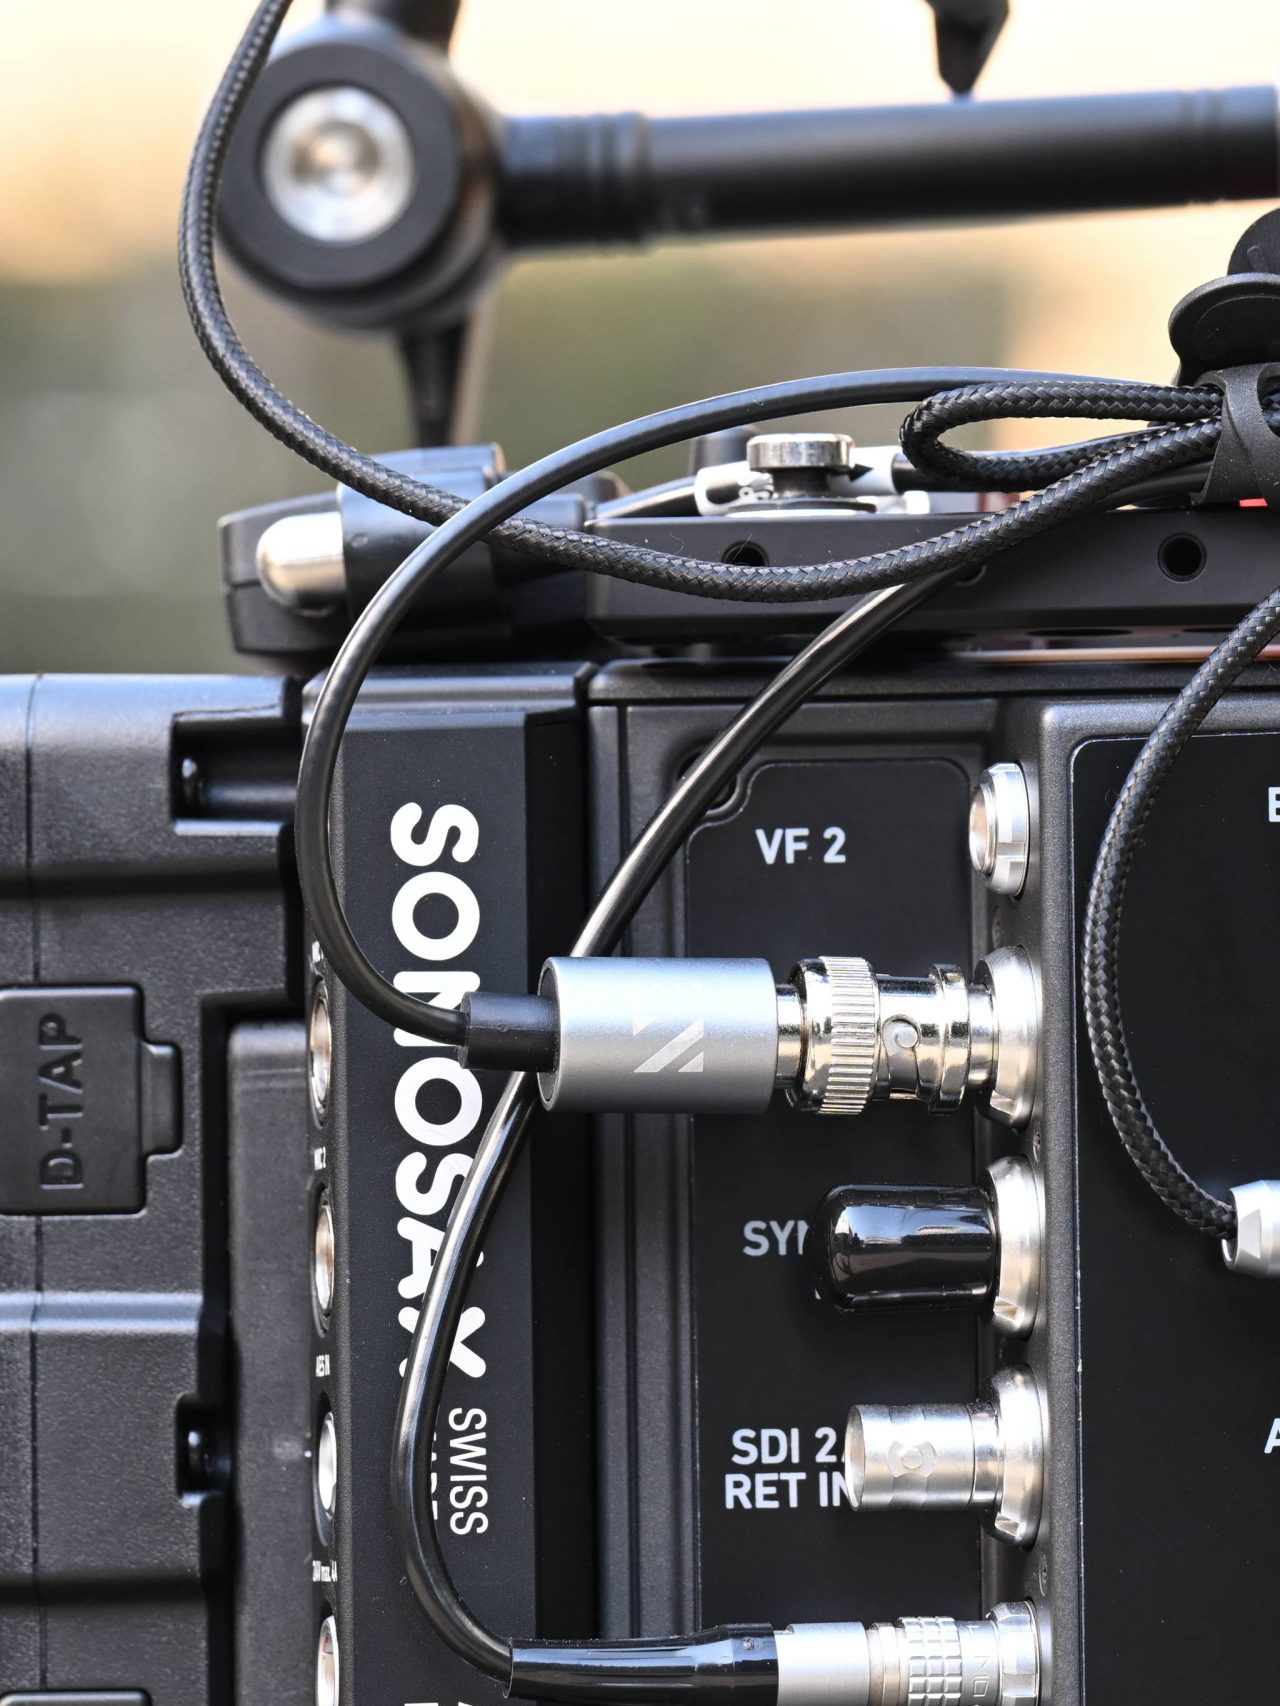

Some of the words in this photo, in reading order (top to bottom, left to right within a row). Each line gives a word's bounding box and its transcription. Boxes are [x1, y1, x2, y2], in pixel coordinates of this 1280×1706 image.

[755, 828, 810, 865] VF
[823, 826, 847, 864] 2
[38, 1013, 84, 1190] D-TAP
[731, 1428, 800, 1465] SDI
[449, 1407, 489, 1536] SWISS
[724, 1471, 807, 1510] RET
